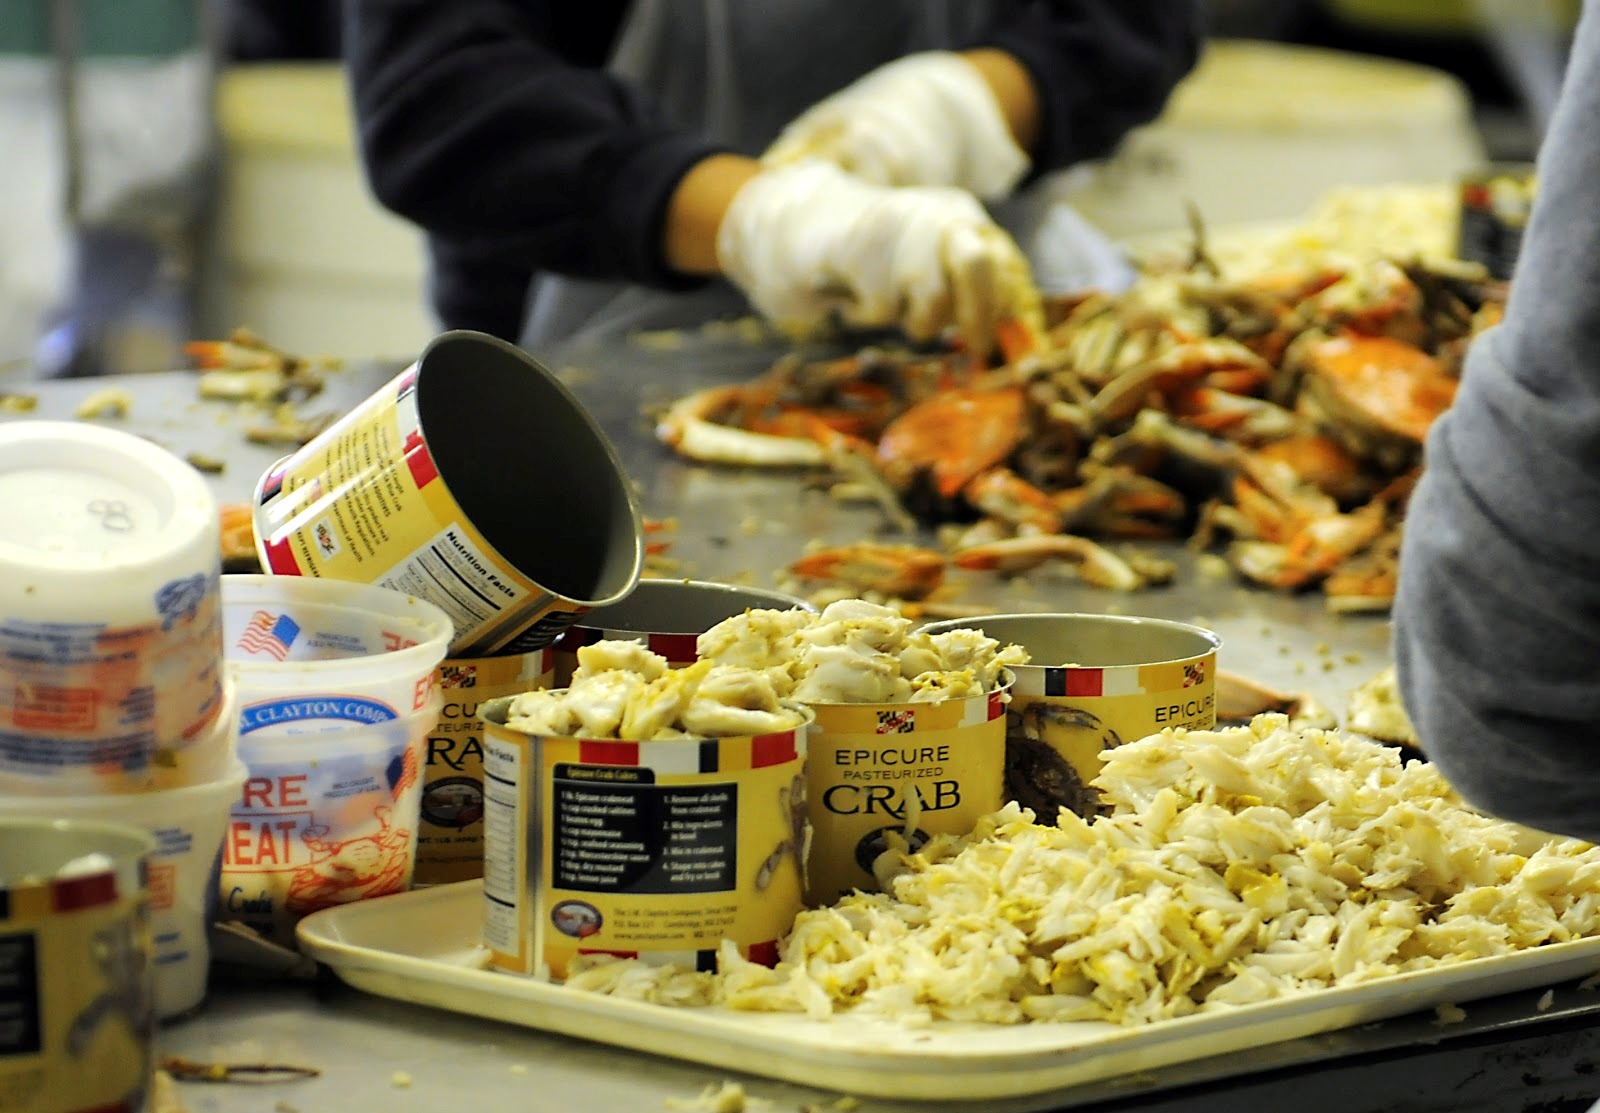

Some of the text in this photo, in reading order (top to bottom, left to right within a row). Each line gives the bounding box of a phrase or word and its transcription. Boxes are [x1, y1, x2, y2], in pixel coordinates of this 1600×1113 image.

[373, 485, 391, 517] ADDITIVES
[386, 483, 395, 497] Blue
[392, 497, 402, 512] Crab
[346, 500, 358, 520] Health
[367, 505, 382, 529] product
[331, 501, 350, 535] epartment
[349, 542, 363, 562] Health
[361, 513, 377, 538] pressure
[296, 531, 306, 546] KEPT
[445, 531, 489, 576] Nutrition
[487, 574, 516, 599] Facts
[256, 701, 340, 723] CLAYTON
[835, 745, 950, 766] EPICURE
[843, 766, 944, 780] PASTEURIZED
